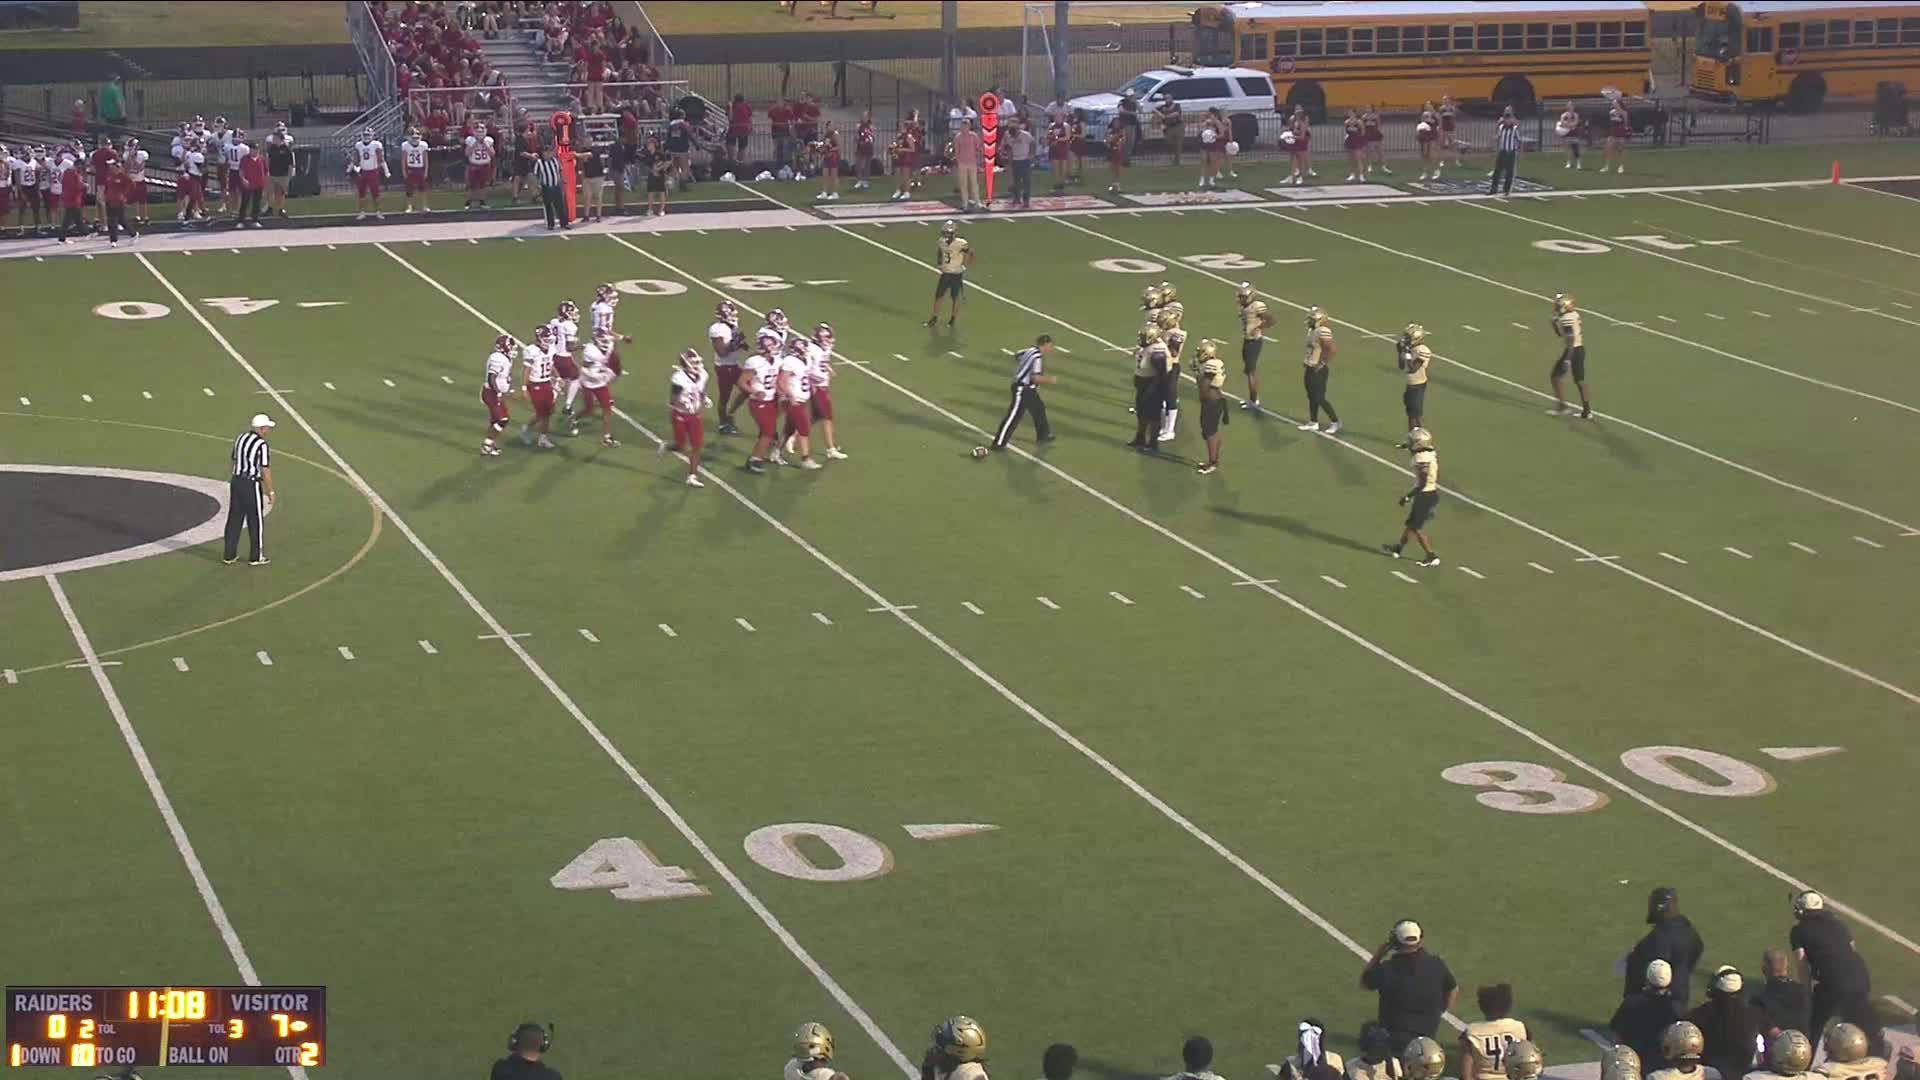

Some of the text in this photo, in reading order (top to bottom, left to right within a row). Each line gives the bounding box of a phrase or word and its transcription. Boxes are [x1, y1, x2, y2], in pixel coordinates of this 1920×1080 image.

[230, 148, 239, 162] 11
[408, 153, 421, 165] 34
[1441, 745, 1778, 814] 30
[550, 822, 895, 901] 40
